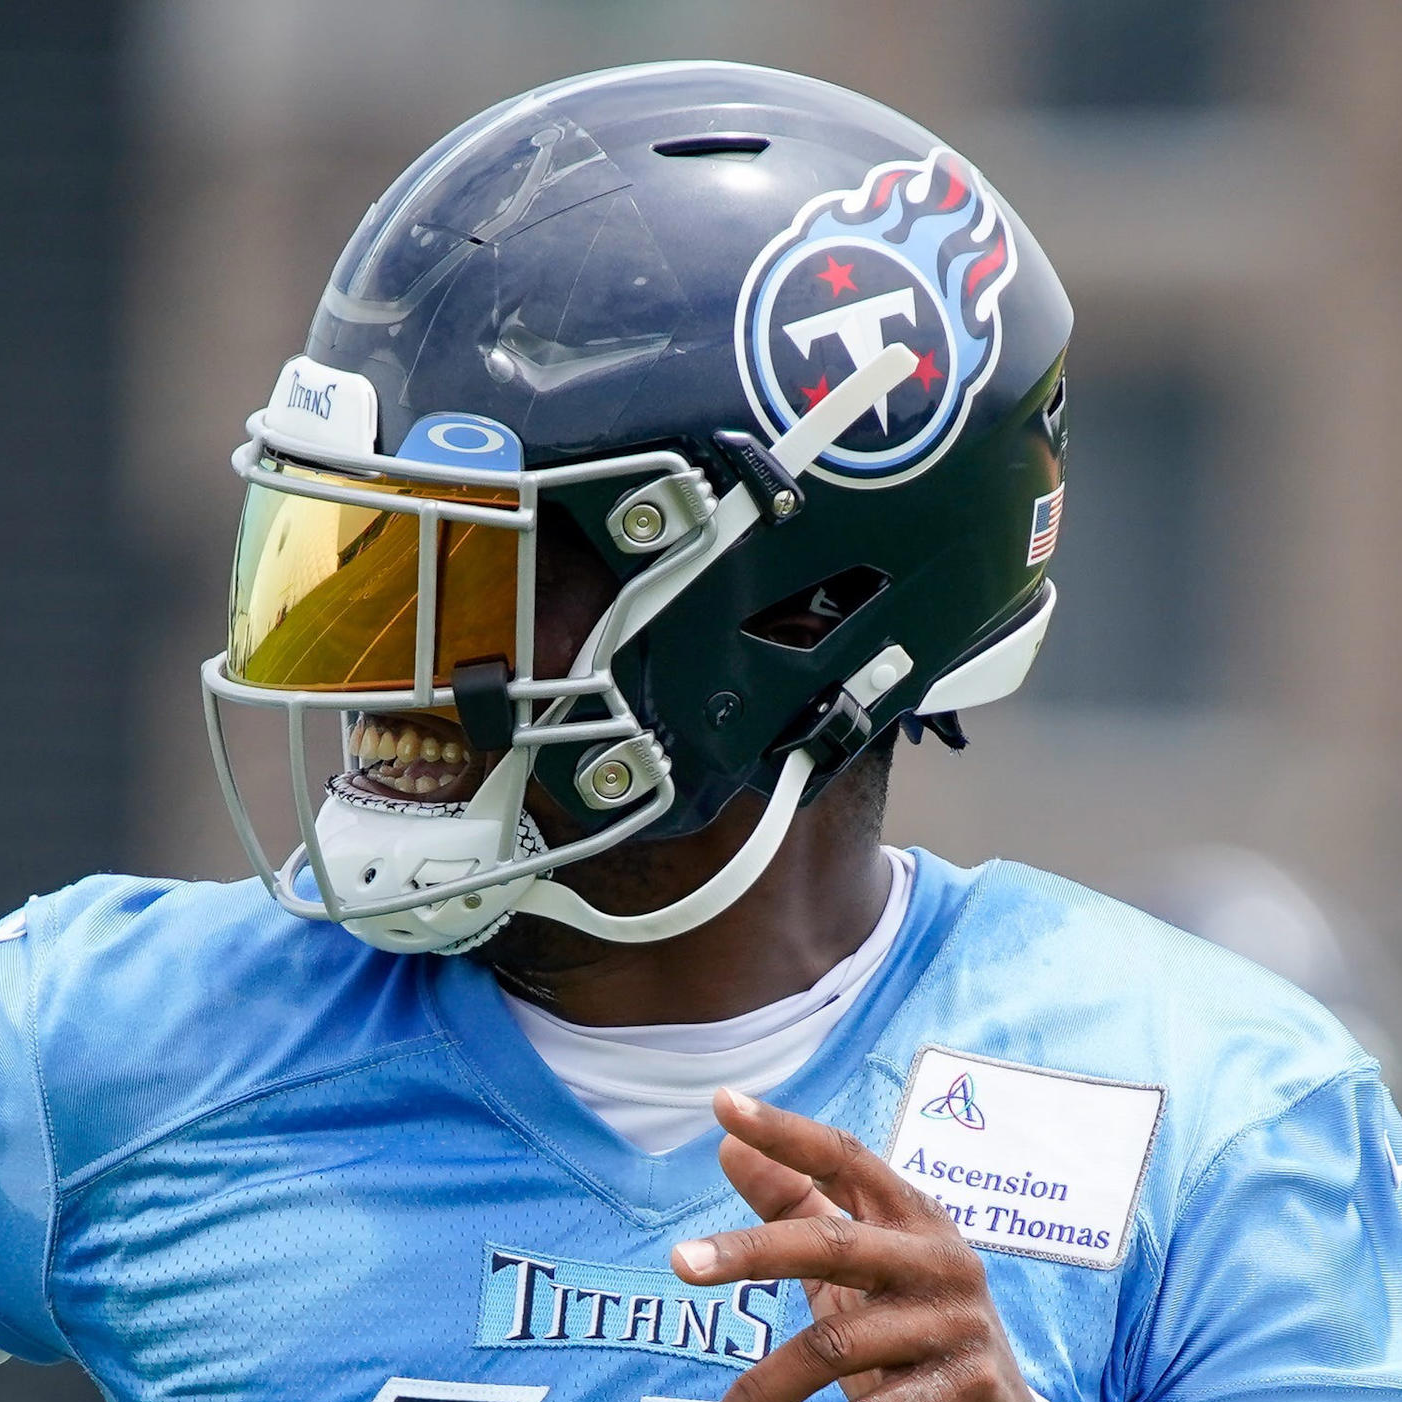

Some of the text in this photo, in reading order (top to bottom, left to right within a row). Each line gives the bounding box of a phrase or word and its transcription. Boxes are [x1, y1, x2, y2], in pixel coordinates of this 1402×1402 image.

[287, 368, 337, 421] TITANS
[902, 1146, 1069, 1202] Ascension
[984, 1204, 1112, 1251] Thomas
[491, 1250, 780, 1363] TITANS
